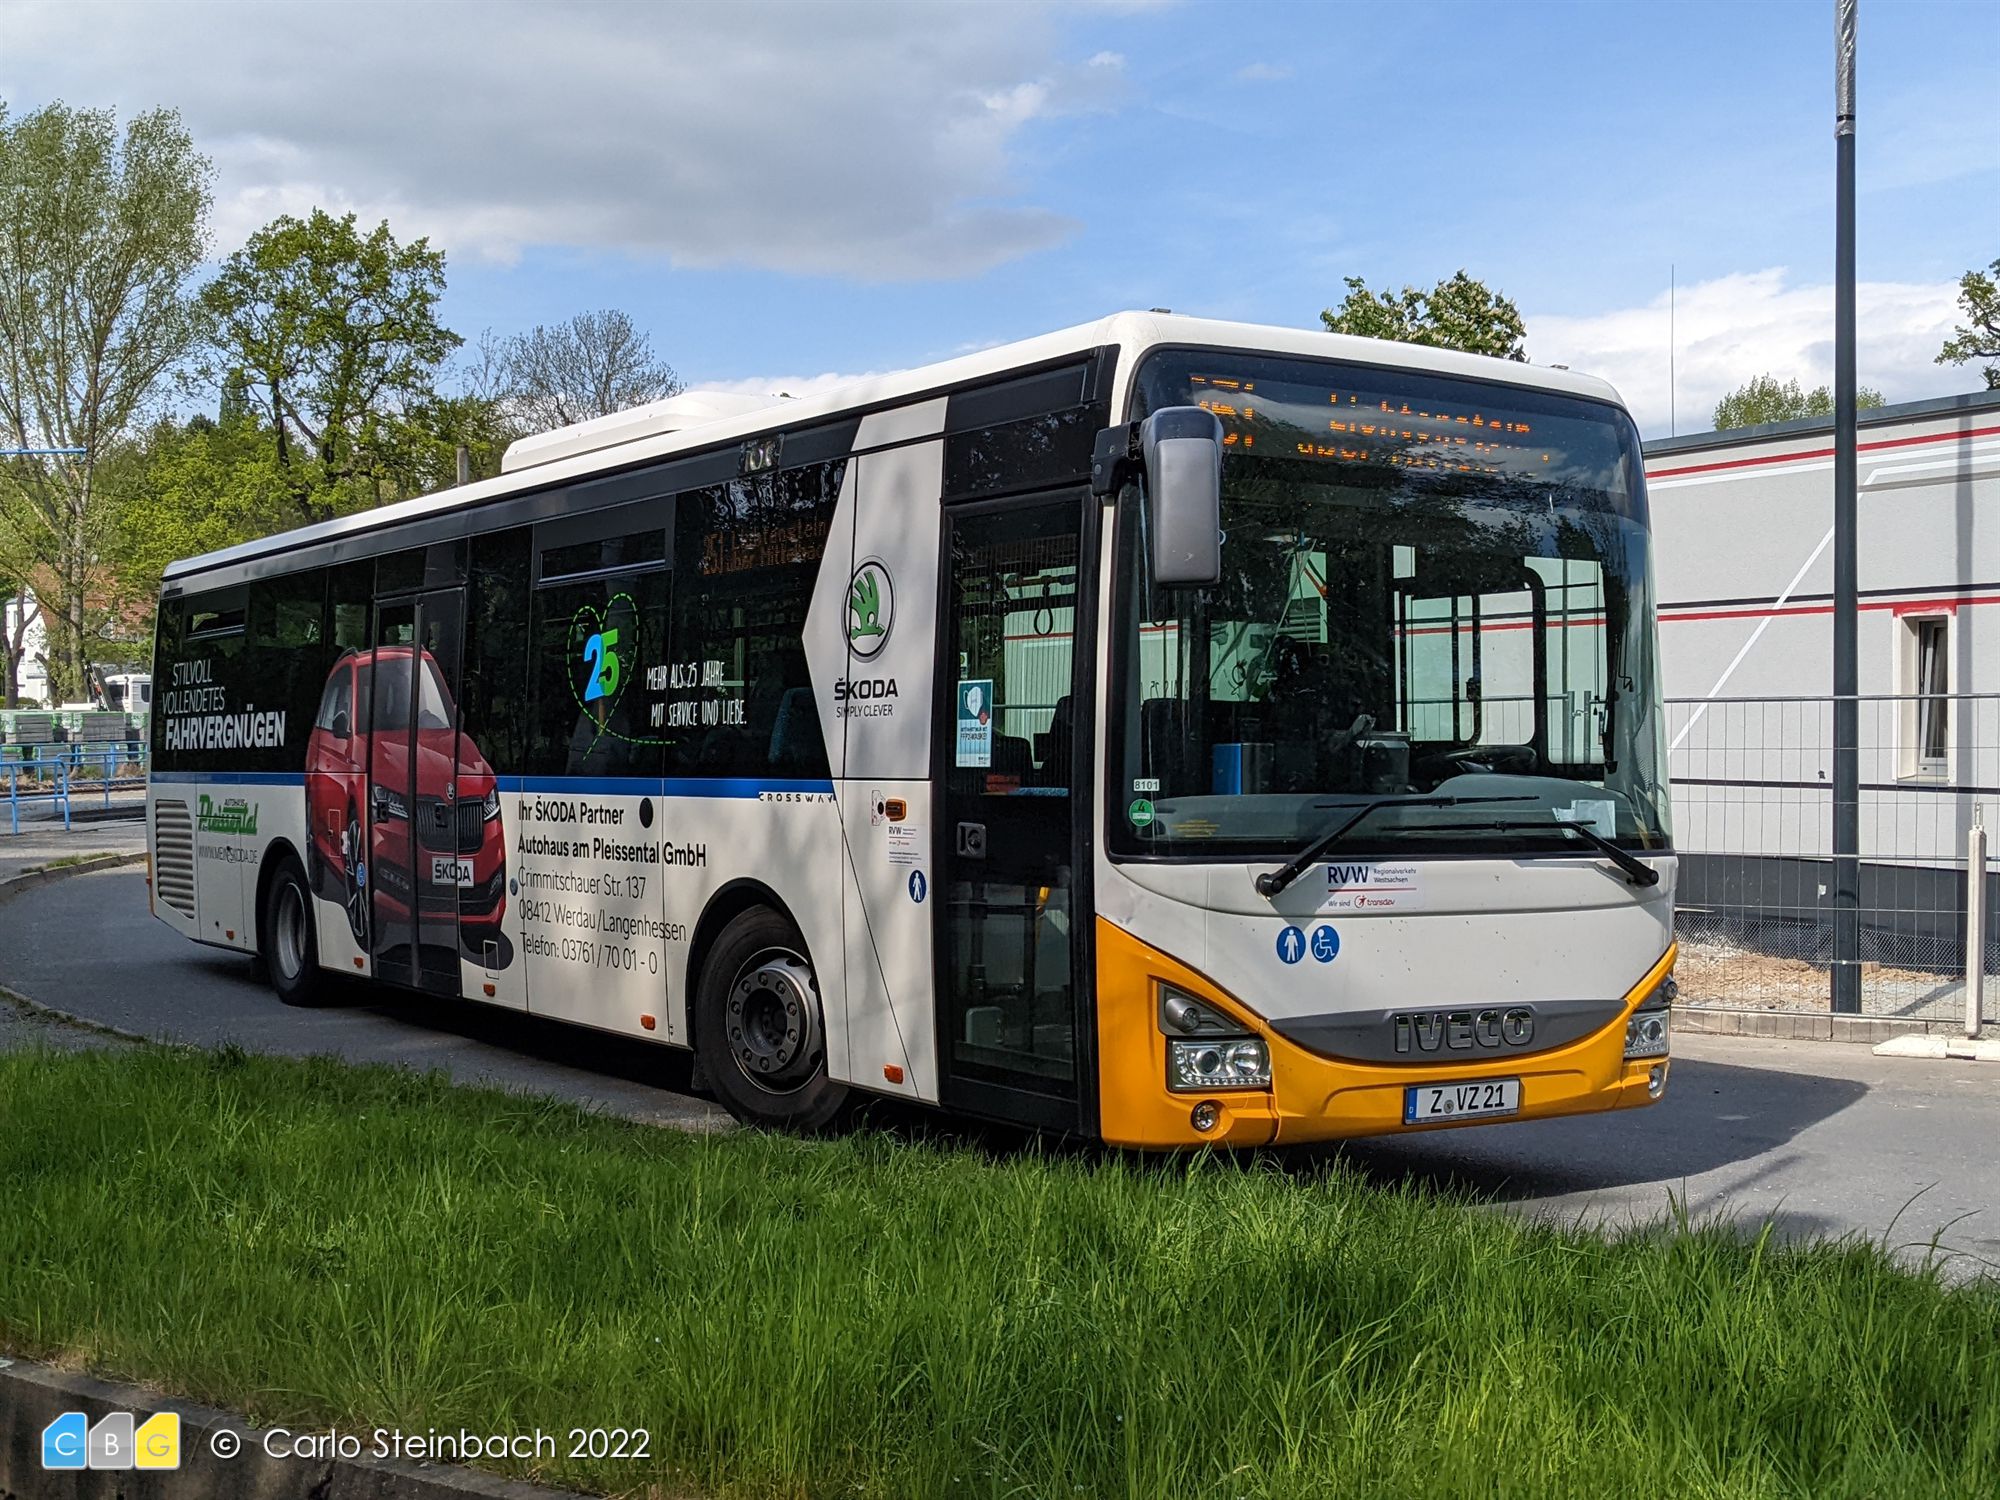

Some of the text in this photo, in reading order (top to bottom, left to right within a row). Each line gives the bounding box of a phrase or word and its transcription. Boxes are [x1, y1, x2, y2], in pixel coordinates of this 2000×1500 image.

[173, 659, 212, 686] STILVOLL
[584, 628, 619, 701] 25
[646, 660, 725, 690] MEHR ALS 25 JAHRE
[162, 686, 225, 715] VOLLENDETES
[834, 677, 898, 700] ŠKODA
[651, 699, 747, 727] MIT SERVICE UND LIEBE.
[864, 704, 893, 717] CLEVER
[166, 703, 286, 750] FAHRVERGNÜGEN
[759, 793, 833, 803] CROSSWAY
[1134, 781, 1158, 790] 8101
[518, 795, 624, 825] Ihr ŠKODA Partner
[1138, 801, 1145, 812] 4
[518, 833, 706, 867] Autohaus am Pleissental GmbH
[518, 865, 646, 899] Crimmitschauer Str. 137
[1327, 866, 1369, 884] RVW
[1373, 868, 1417, 876] Regionalverkehr
[519, 899, 551, 923] 08412
[520, 932, 559, 958] Telefon:
[605, 945, 620, 968] 70
[623, 947, 637, 971] 01
[648, 951, 657, 974] 0
[1395, 1008, 1534, 1053] IVECO
[1430, 1090, 1443, 1113] Z
[1457, 1087, 1480, 1111] VZ
[1483, 1084, 1504, 1109] 21
